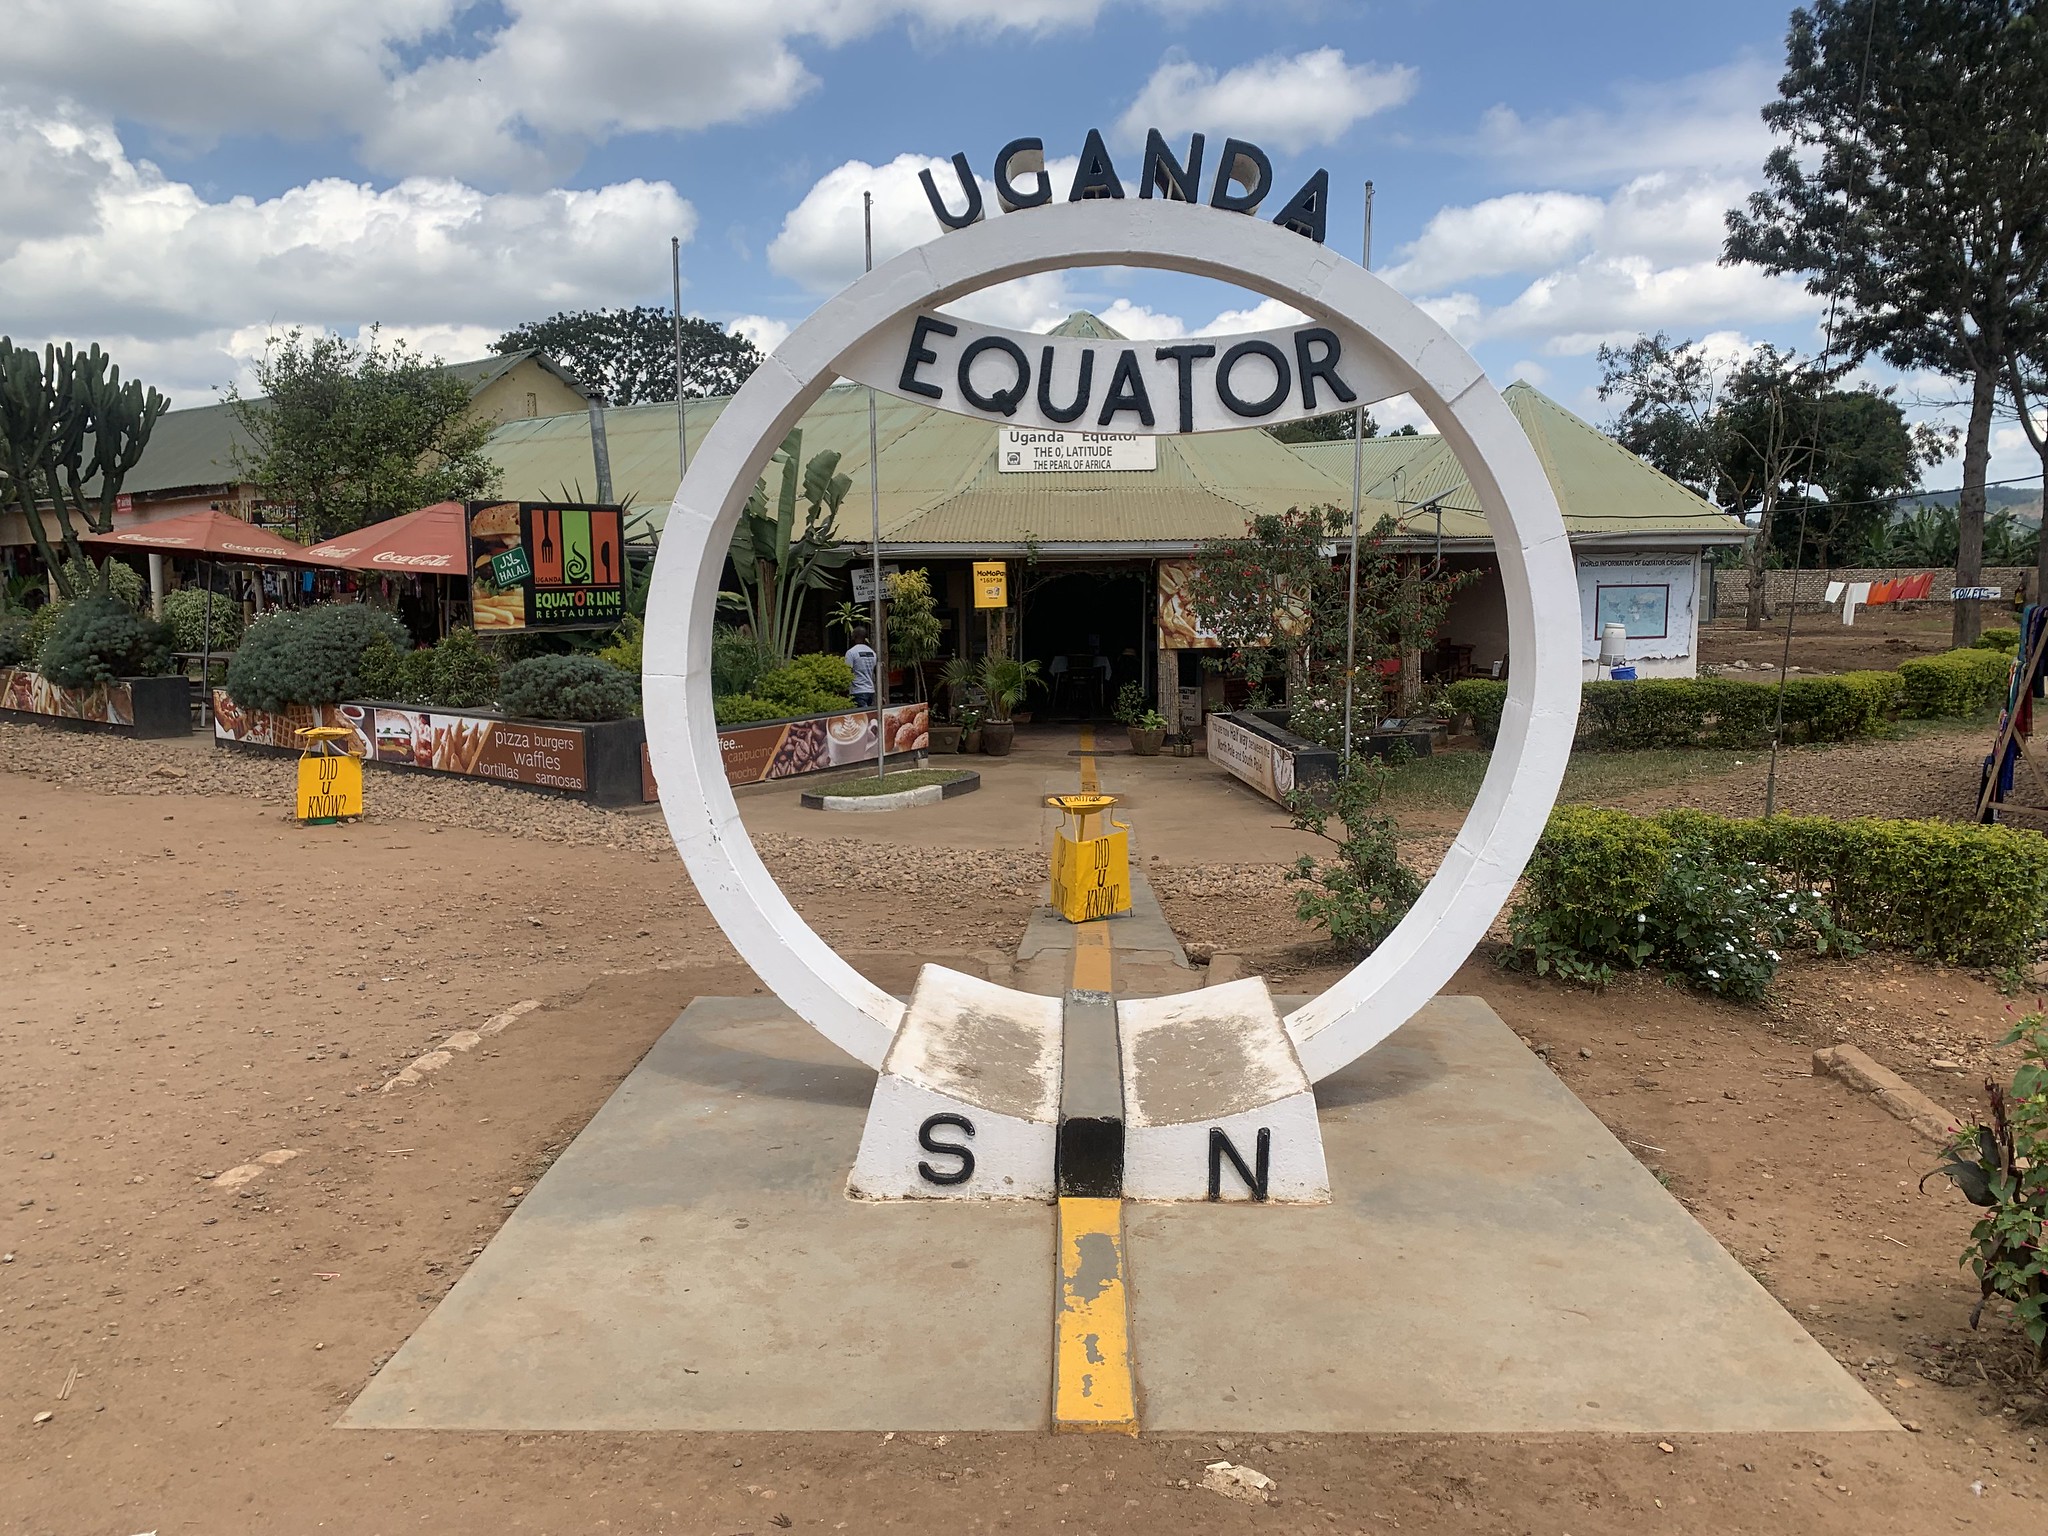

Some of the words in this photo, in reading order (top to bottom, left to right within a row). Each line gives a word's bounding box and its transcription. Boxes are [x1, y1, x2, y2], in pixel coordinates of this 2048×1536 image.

[918, 127, 1329, 244] UGANDA
[899, 314, 1358, 434] EQUATOR
[1010, 431, 1064, 445] Uganda
[1034, 447, 1053, 458] THE
[1066, 446, 1112, 457] LATITUDE
[1034, 460, 1048, 470] THE
[1049, 460, 1072, 470] PEARL
[1074, 460, 1084, 470] OF
[1085, 460, 1112, 470] AFRICA
[499, 564, 528, 582] HALAL
[598, 591, 621, 606] LINE
[536, 608, 621, 618] RESTAURANT
[495, 728, 530, 748] pizza
[534, 732, 574, 752] burgers
[1230, 725, 1238, 742] Half
[1240, 733, 1248, 750] way
[1248, 738, 1263, 756] between
[513, 750, 560, 770] waffles
[1217, 738, 1227, 753] North
[1242, 751, 1254, 768] South
[319, 758, 338, 780] DID
[479, 760, 519, 780] tortillas
[536, 772, 582, 789] samosas
[728, 766, 758, 780] mocha
[308, 794, 347, 818] KNOW?
[1094, 838, 1110, 870] DID
[1098, 870, 1106, 887] U
[1085, 884, 1120, 919] KNOW?
[917, 1112, 976, 1186] S
[1209, 1126, 1271, 1200] N
